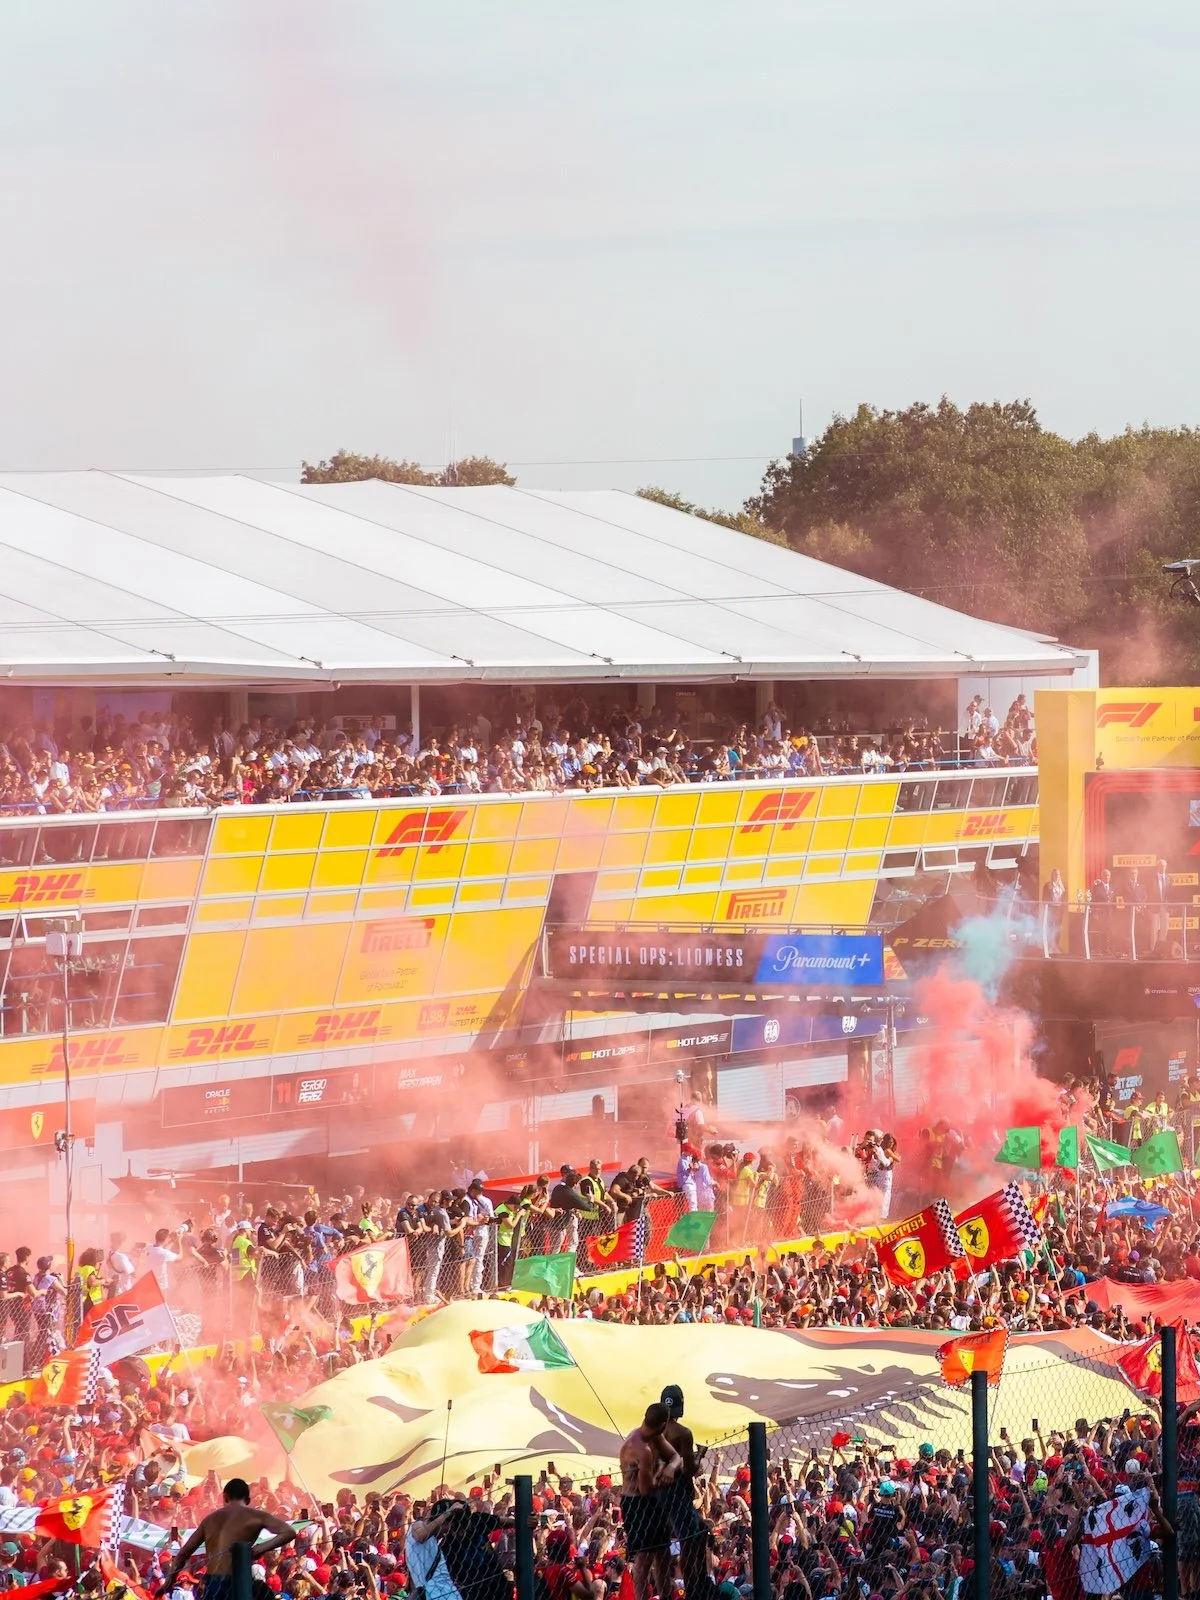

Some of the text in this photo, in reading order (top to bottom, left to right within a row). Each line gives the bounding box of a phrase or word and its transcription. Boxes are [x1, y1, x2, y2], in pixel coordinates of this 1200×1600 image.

[1152, 734, 1176, 742] Partner
[740, 791, 816, 833] F1
[376, 811, 467, 857] F1
[963, 814, 1007, 836] DHL
[12, 874, 84, 901] DHL
[725, 889, 787, 920] PIRELLI
[360, 918, 436, 953] PIRELLI
[892, 938, 909, 947] P
[569, 945, 632, 965] SPECIAL
[773, 945, 871, 974] Paramount+
[310, 1010, 382, 1042] DHL
[183, 1023, 259, 1057] DHL
[677, 1038, 696, 1048] HOT
[45, 1038, 126, 1072] DHL
[592, 1049, 611, 1059] HOT
[205, 1089, 231, 1099] ORACLE
[276, 1083, 290, 1104] 11
[300, 1079, 327, 1091] SERGIO
[298, 1091, 323, 1104] PEREZ
